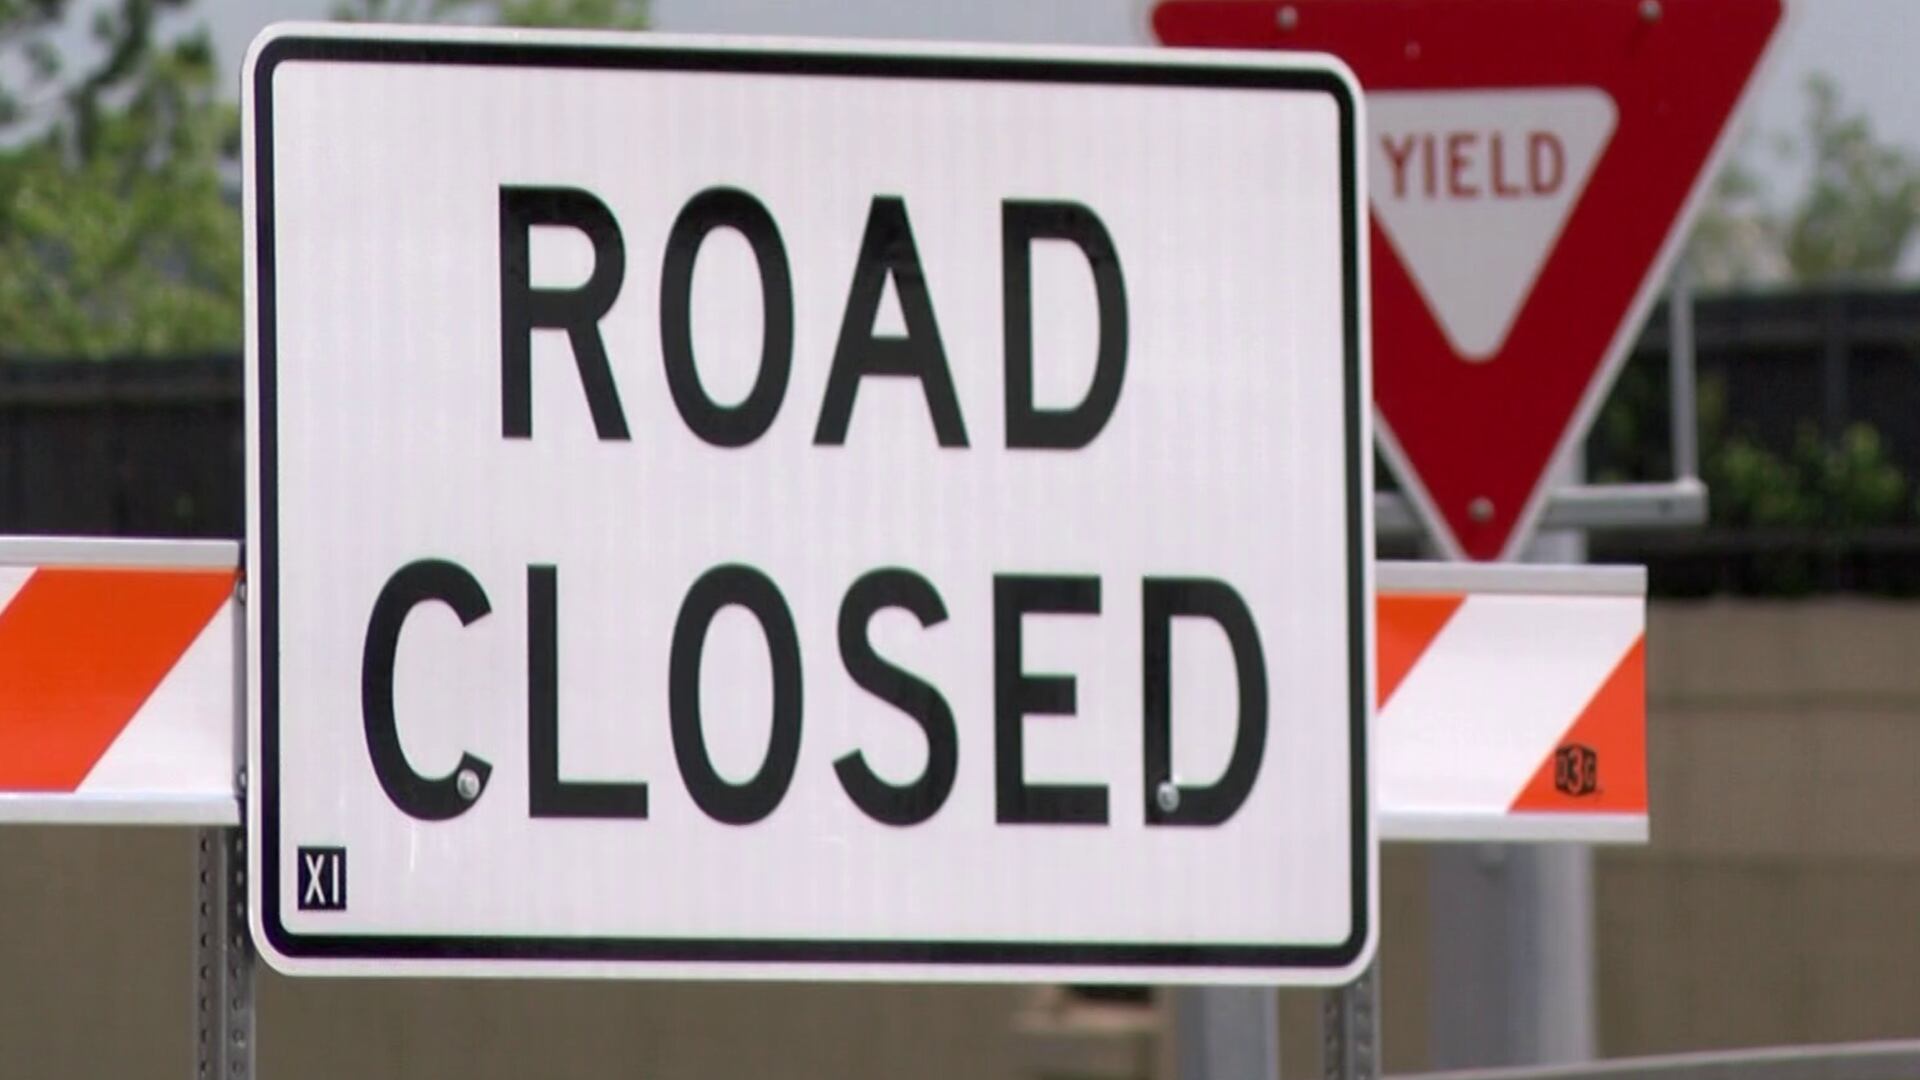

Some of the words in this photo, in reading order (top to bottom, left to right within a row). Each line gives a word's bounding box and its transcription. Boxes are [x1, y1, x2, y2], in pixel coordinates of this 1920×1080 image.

[1380, 129, 1567, 200] YIELD
[499, 185, 1129, 450] ROAD
[362, 559, 1269, 827] CLOSED
[304, 854, 340, 906] XI
